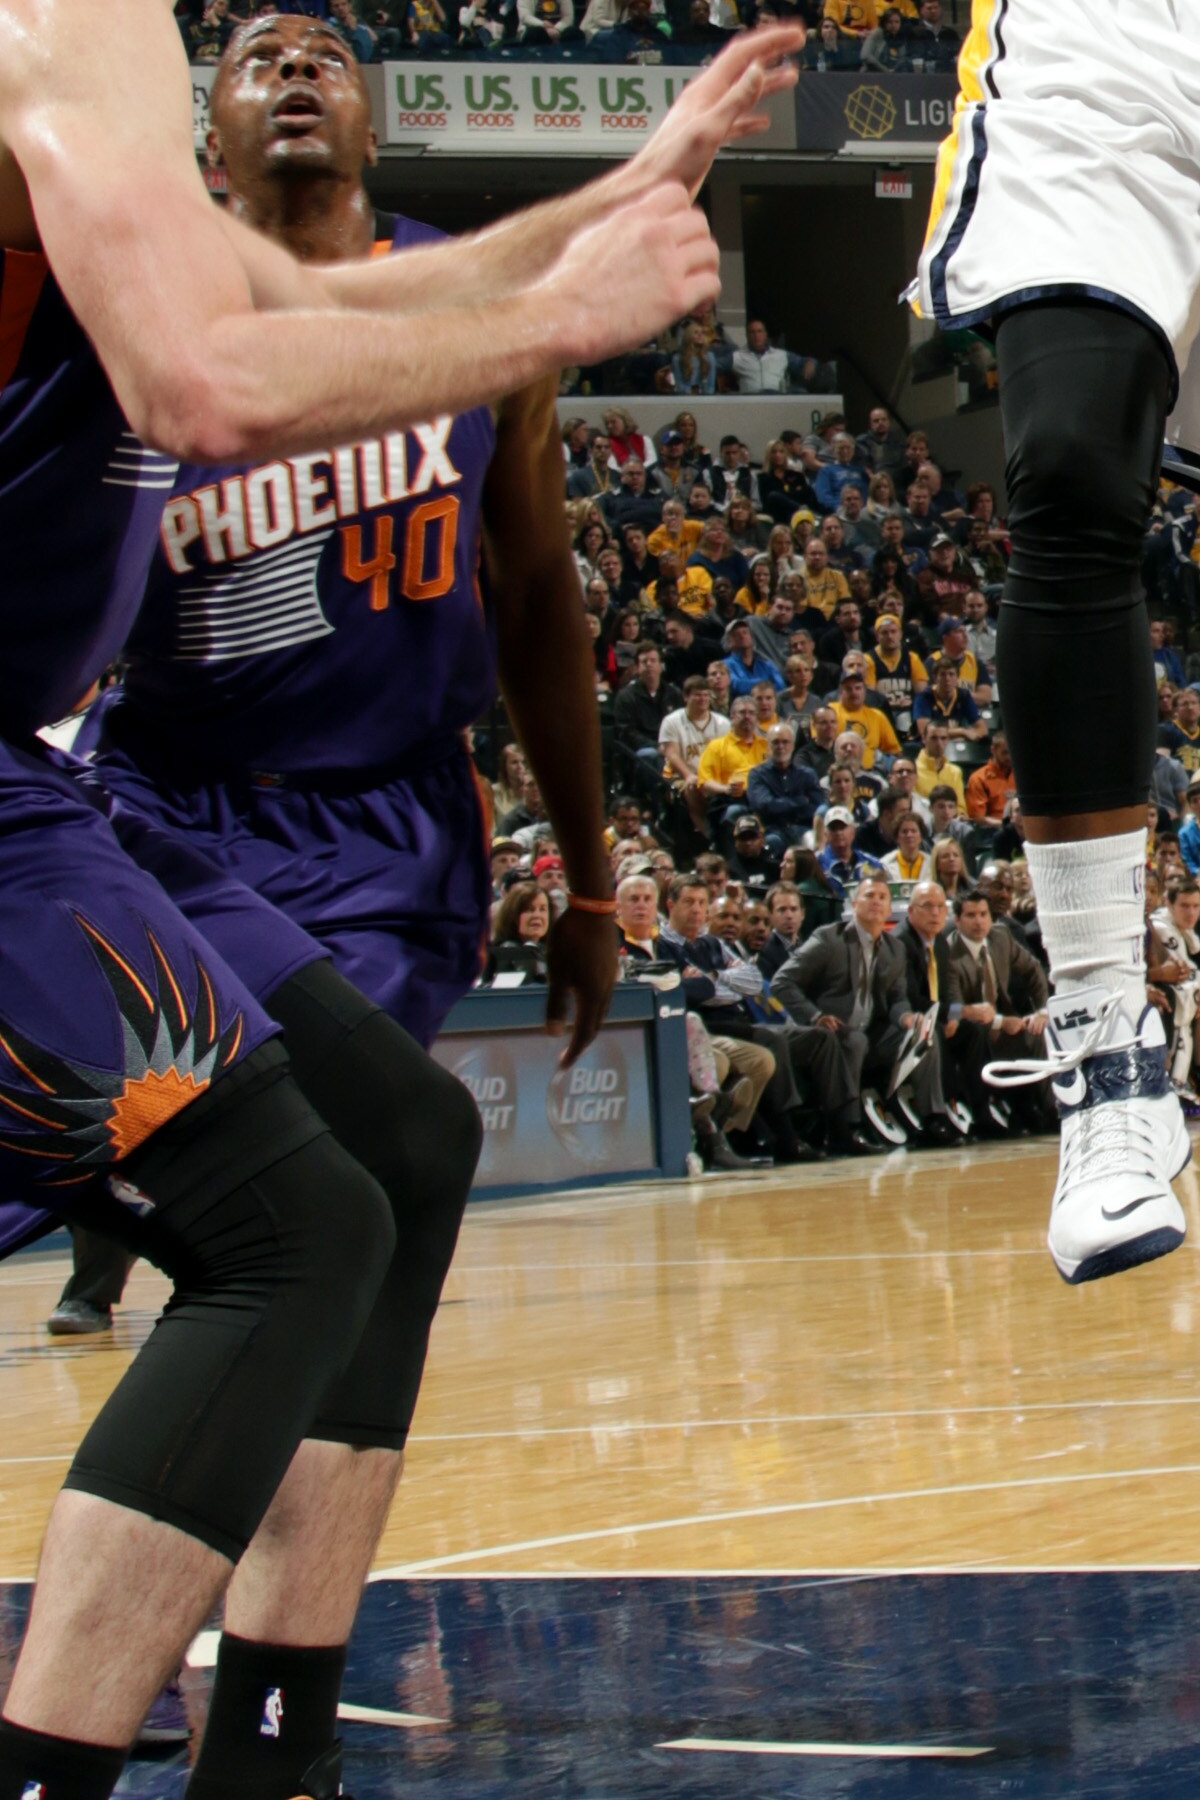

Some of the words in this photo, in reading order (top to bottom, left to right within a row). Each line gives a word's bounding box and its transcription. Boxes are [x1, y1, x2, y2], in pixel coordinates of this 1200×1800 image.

[399, 113, 447, 127] FOODS
[467, 113, 514, 127] FOODS
[534, 113, 581, 128] FOODS
[601, 114, 648, 128] FOODS
[882, 173, 907, 194] EXIT
[161, 417, 462, 574] PHOENIX
[340, 495, 460, 611] 40
[569, 1067, 619, 1095] BUD
[560, 1096, 626, 1125] LIGHT
